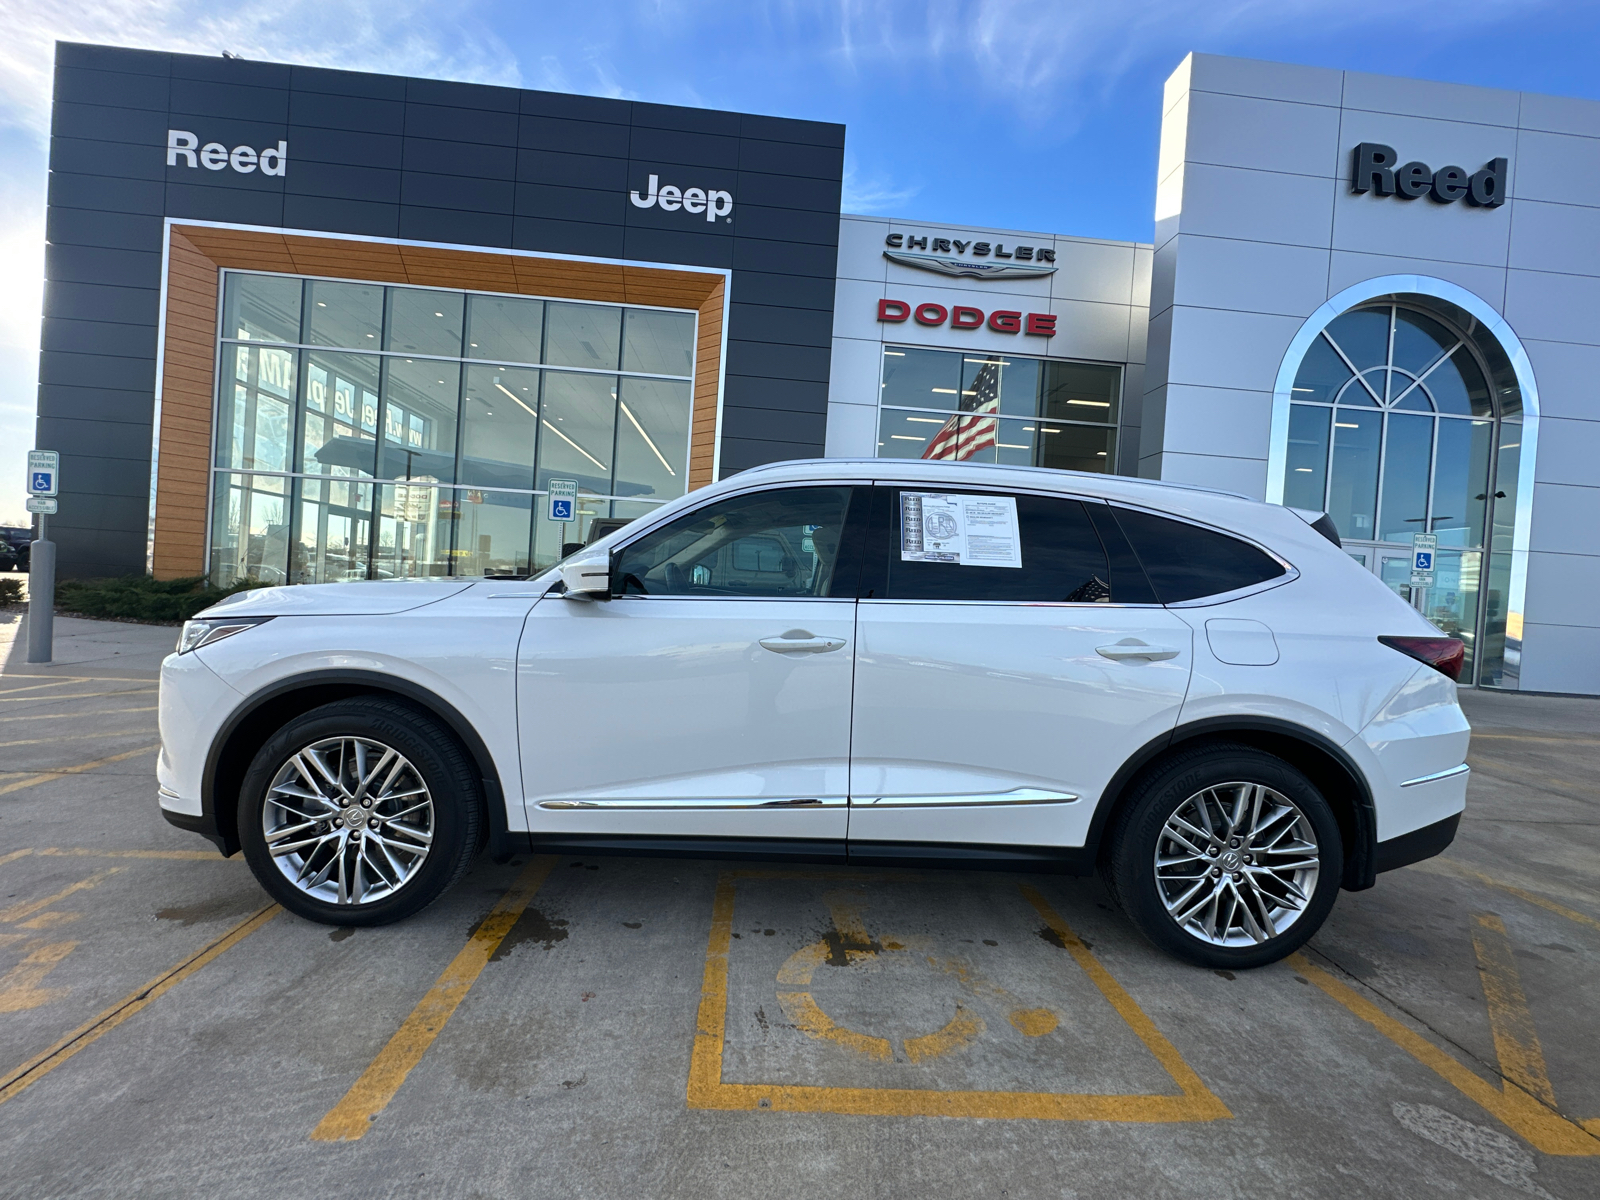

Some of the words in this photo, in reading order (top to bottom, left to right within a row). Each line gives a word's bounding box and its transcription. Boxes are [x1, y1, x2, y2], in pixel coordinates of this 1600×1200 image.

[167, 129, 287, 177] Reed
[1351, 142, 1508, 208] Reed
[630, 174, 733, 223] Jeep
[885, 233, 1057, 262] CHRYSLER
[877, 298, 1058, 338] DODGE
